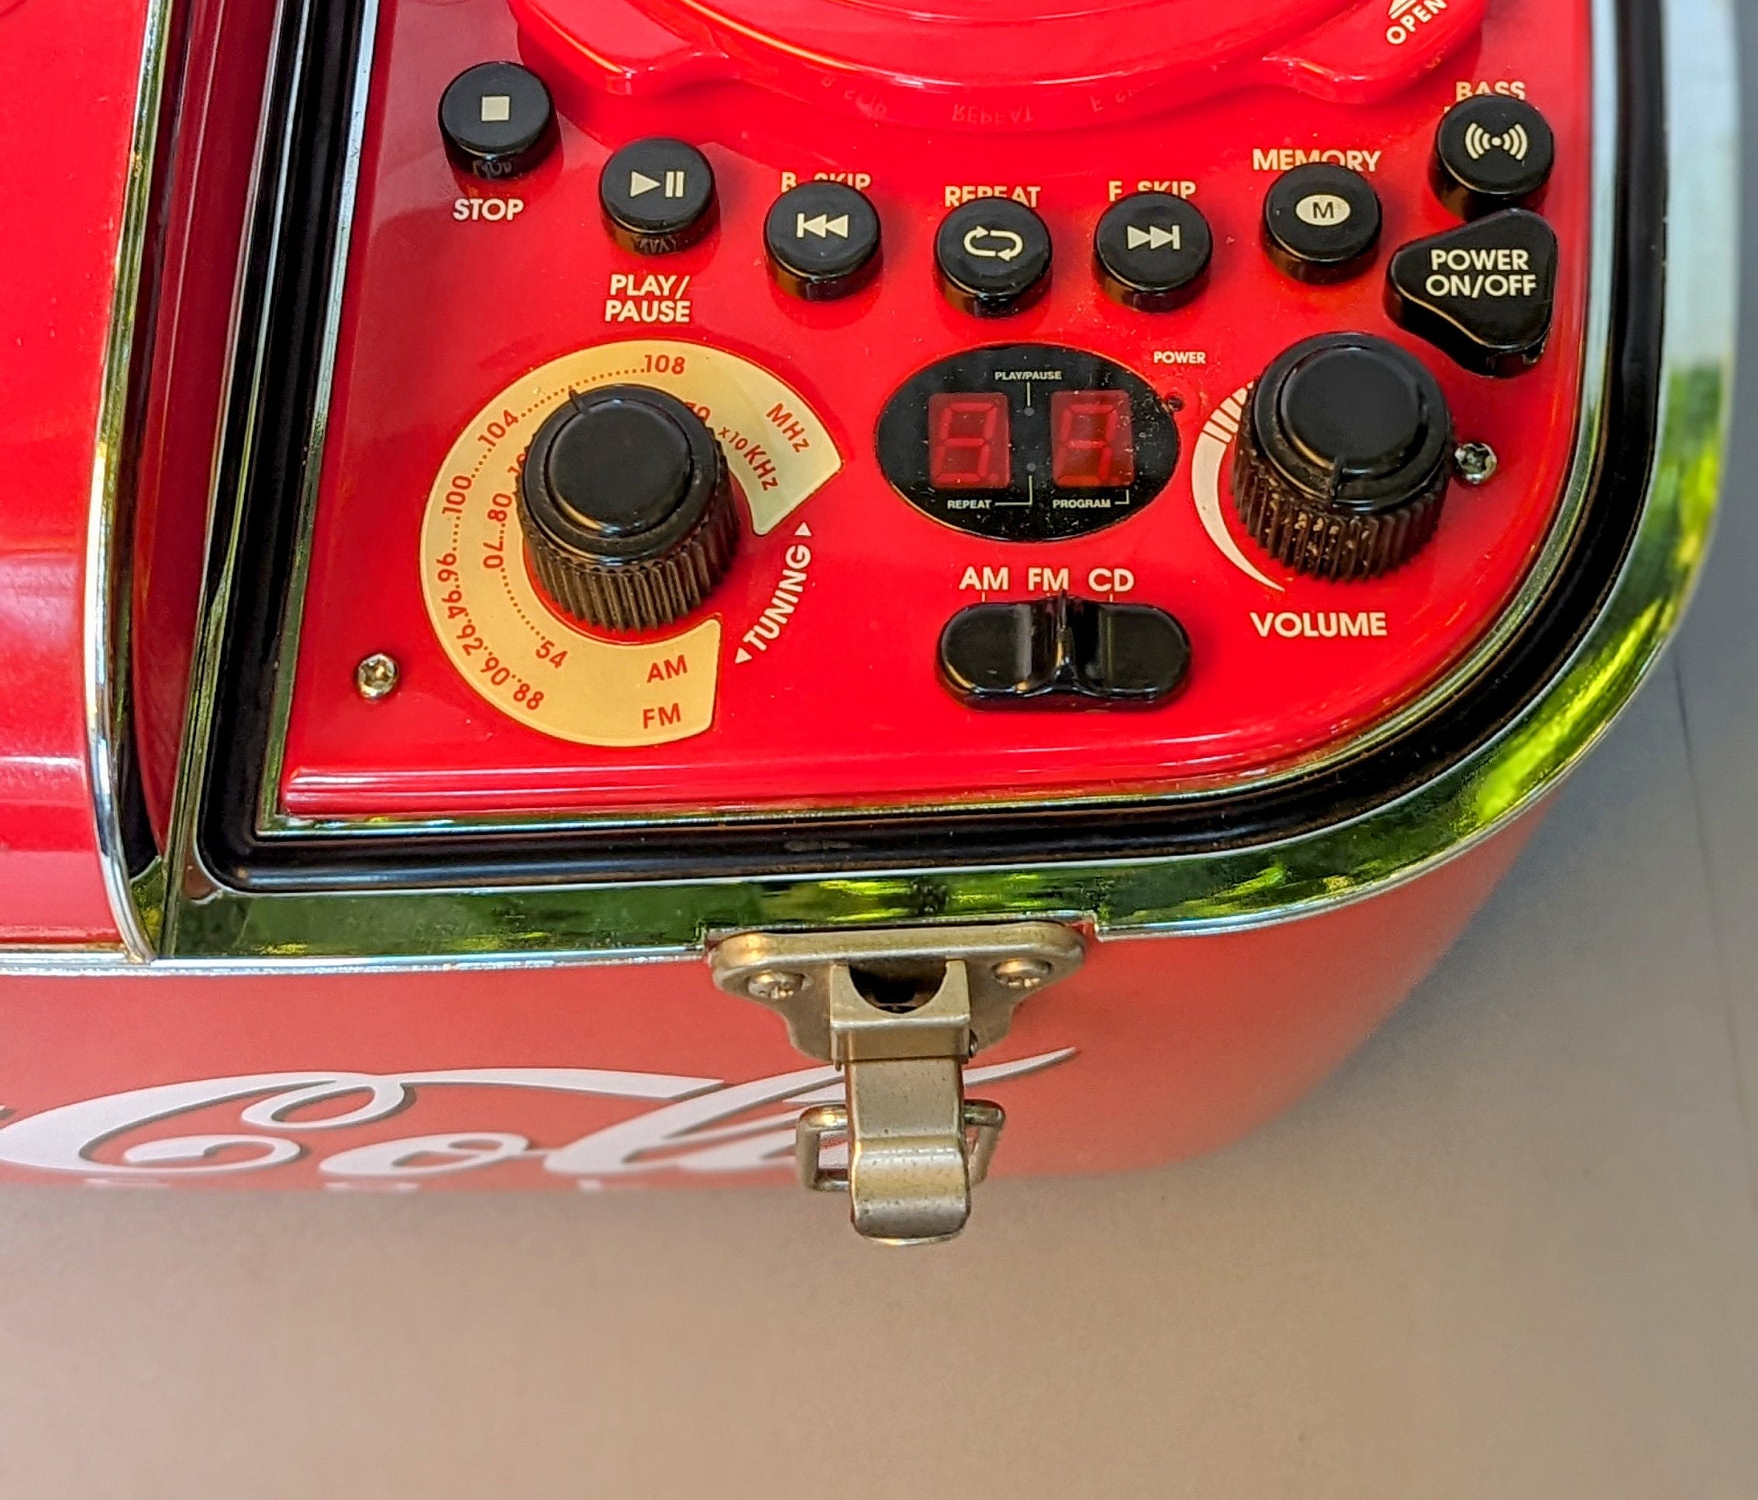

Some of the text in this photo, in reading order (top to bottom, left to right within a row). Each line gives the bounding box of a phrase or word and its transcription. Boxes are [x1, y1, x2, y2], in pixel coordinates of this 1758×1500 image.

[1251, 147, 1383, 173] MEMORY
[452, 198, 525, 221] STOP
[1312, 200, 1335, 220] M
[1429, 248, 1530, 272] POWER
[609, 273, 691, 300] PLAY/
[1425, 273, 1537, 300] ON/OFF
[604, 300, 692, 323] PAUSE
[643, 353, 686, 375] 108
[1152, 351, 1207, 365] POWER
[994, 370, 1063, 381] PLAY/PAUSE
[476, 408, 520, 448] 104
[765, 401, 811, 453] MHz
[441, 473, 473, 516] 100
[486, 491, 513, 523] 80
[946, 499, 992, 510] REPEAT
[1052, 499, 1112, 510] PROGRAM
[435, 551, 458, 583] 96
[482, 539, 504, 570] 70
[958, 566, 1136, 592] AM FM CD
[441, 588, 468, 619] 94
[743, 544, 812, 652] TUNING
[1249, 611, 1388, 639] VOLUME
[455, 622, 484, 657] 92
[534, 639, 569, 669] 54
[479, 655, 511, 686] 90
[645, 654, 689, 684] AM
[512, 682, 545, 711] 88
[642, 702, 682, 730] FM
